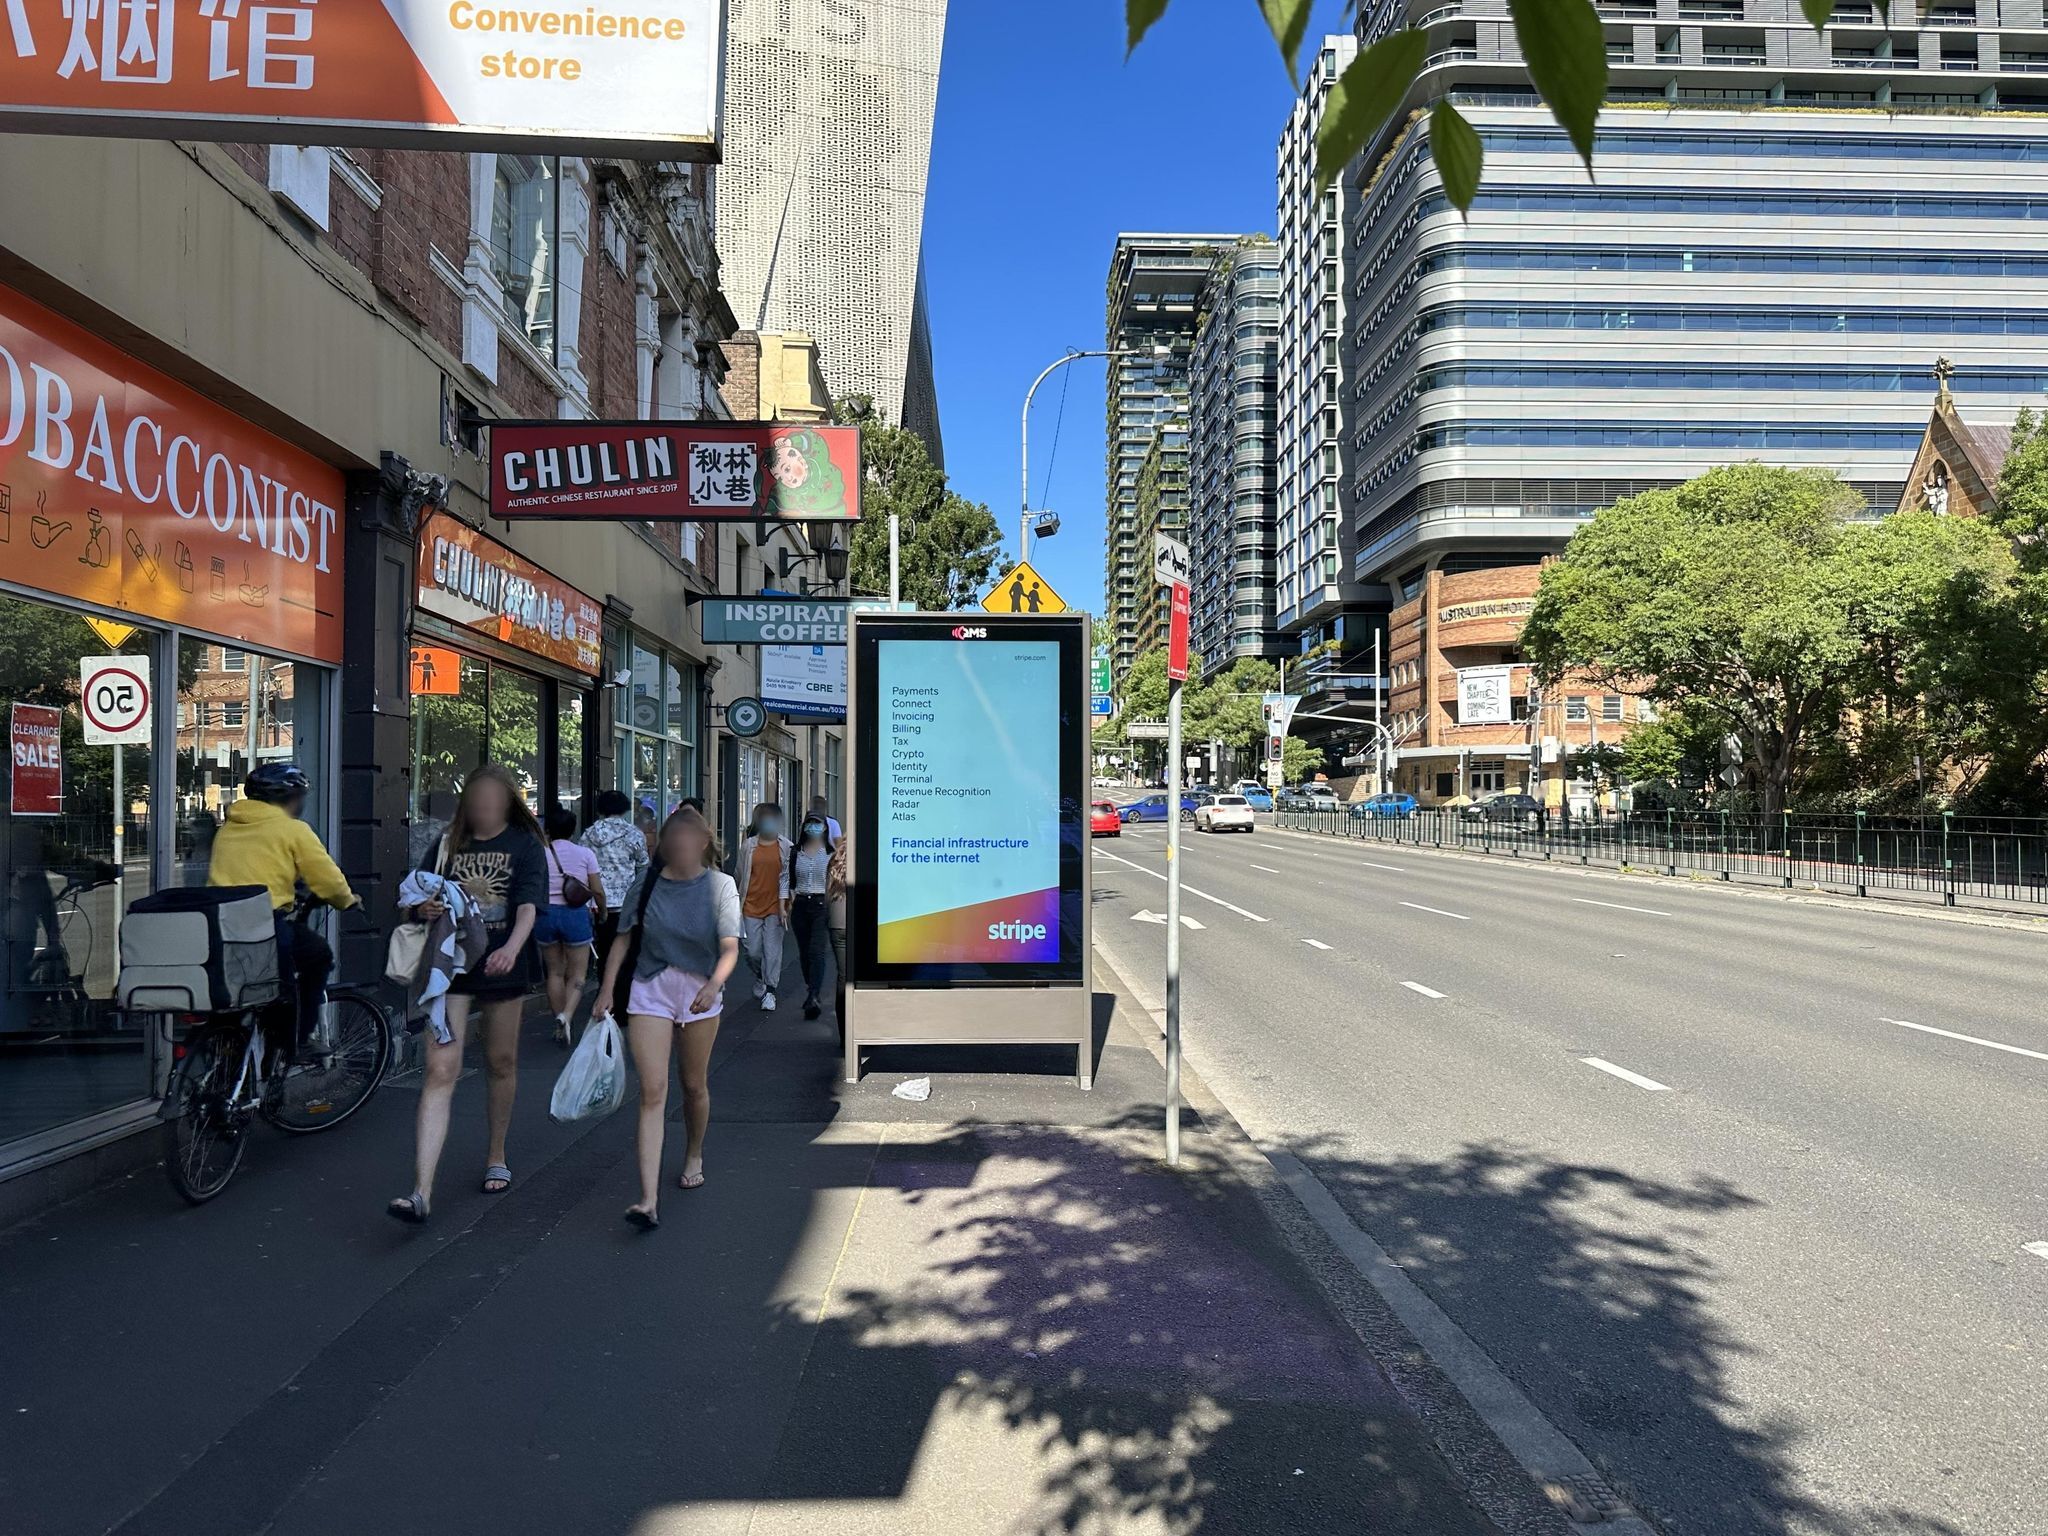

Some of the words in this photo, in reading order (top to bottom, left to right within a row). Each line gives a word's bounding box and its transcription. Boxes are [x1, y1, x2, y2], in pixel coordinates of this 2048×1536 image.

[449, 0, 686, 41] Convenience
[6, 0, 316, 90] 烟馆
[480, 50, 582, 80] store
[503, 436, 672, 491] CHULIN
[507, 496, 549, 508] AUTHENTIC
[551, 493, 583, 504] CHINESE
[584, 488, 634, 501] RESTAURANT
[636, 485, 658, 495] SINCE
[660, 483, 678, 493] 2017
[433, 535, 500, 614] CHULIN
[1501, 602, 1532, 614] HOTE
[954, 626, 987, 640] QMS
[806, 683, 833, 692] CBRE
[892, 686, 939, 697] Payments
[1467, 689, 1489, 699] CHAPTER
[892, 699, 932, 708] Connect
[1467, 701, 1486, 710] COMING
[892, 712, 935, 722] Invoicing
[1468, 709, 1479, 718] LATE
[13, 723, 59, 738] CLEARANCE
[892, 724, 921, 735] Billing
[892, 737, 909, 745] Tax
[15, 741, 59, 769] SALE
[892, 749, 925, 760] Crypto
[892, 762, 928, 772] Identity
[892, 774, 933, 783] Terminal
[892, 787, 933, 796] Revenue
[935, 787, 991, 798] Recognition
[892, 800, 920, 809] Radar
[892, 812, 916, 821] Atlas
[892, 837, 945, 848] Financial
[948, 837, 1029, 848] infrastructure
[892, 852, 908, 863] for
[911, 852, 931, 863] the
[933, 852, 980, 863] internet
[988, 919, 1047, 944] stripe
